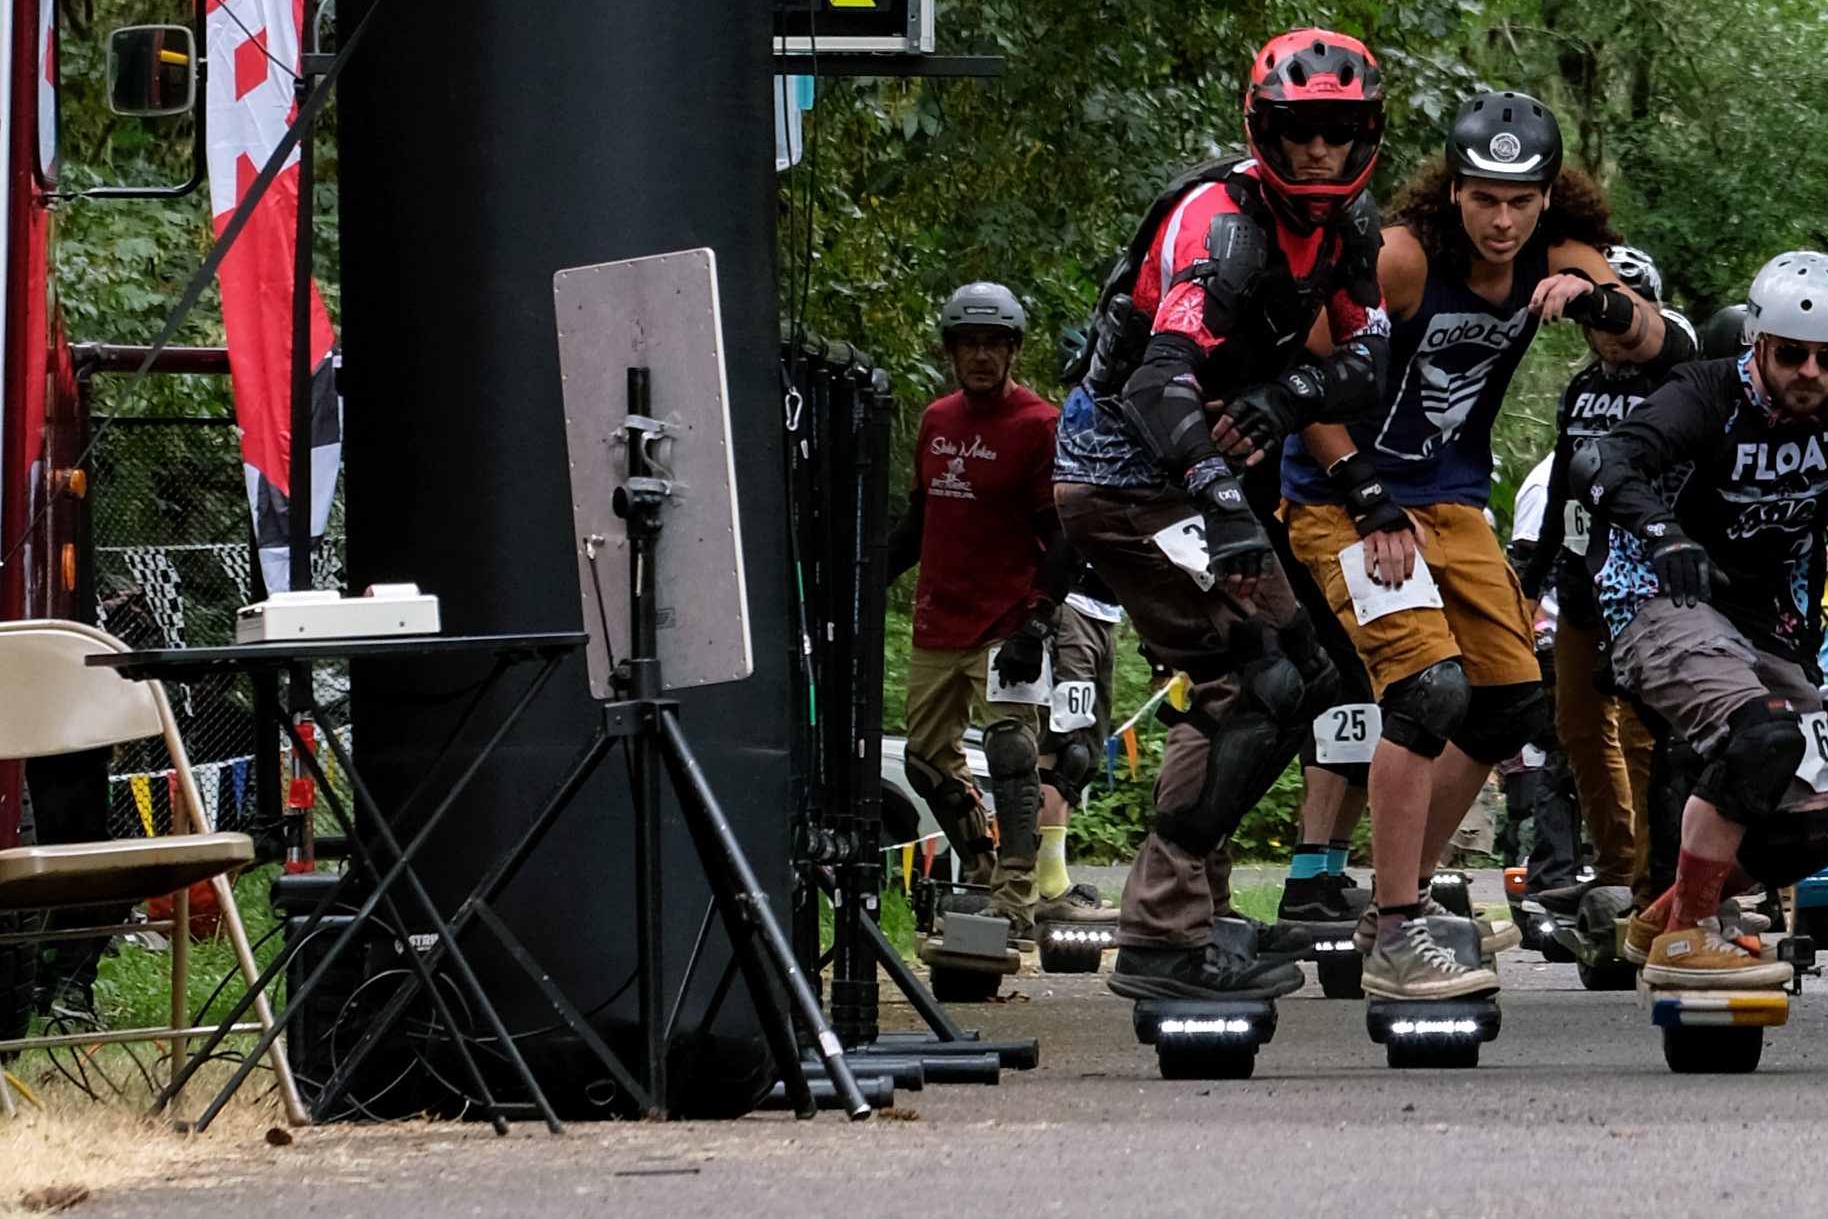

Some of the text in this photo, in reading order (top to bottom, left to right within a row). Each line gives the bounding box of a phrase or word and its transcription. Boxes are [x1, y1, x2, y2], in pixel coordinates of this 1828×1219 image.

[1570, 392, 1646, 421] FLOAT
[1574, 504, 1592, 536] 6
[1068, 686, 1091, 715] 60
[1332, 709, 1367, 742] 25
